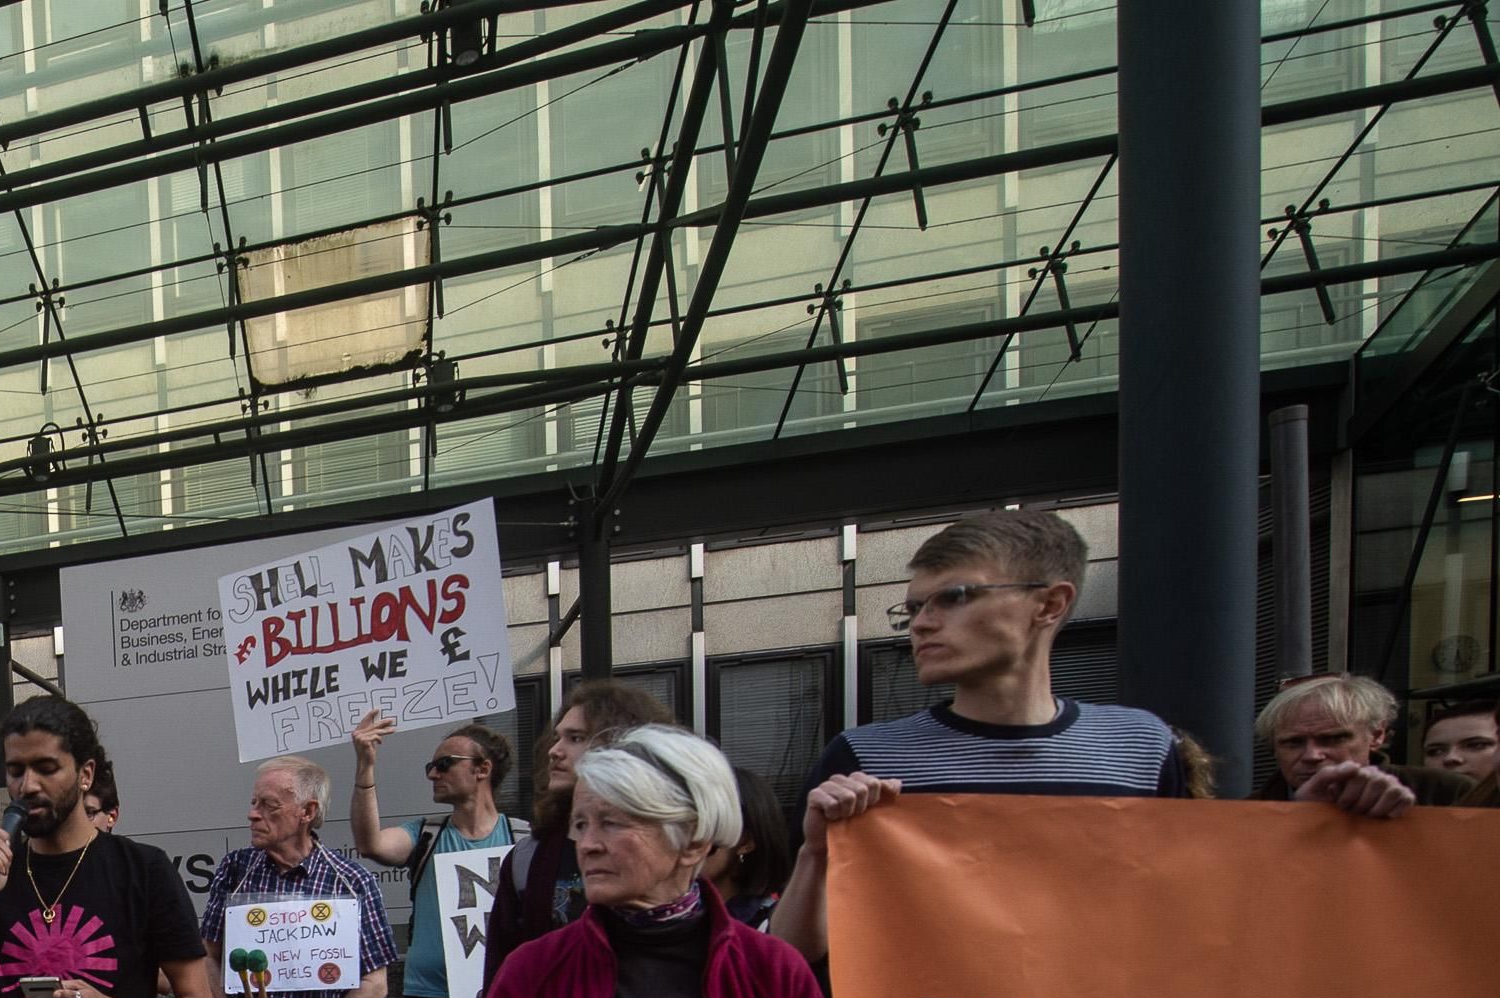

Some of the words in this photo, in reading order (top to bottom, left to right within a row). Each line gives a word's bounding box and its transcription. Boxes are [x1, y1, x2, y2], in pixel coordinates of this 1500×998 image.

[229, 556, 334, 624] SHELL
[349, 512, 474, 588] MAKES
[120, 610, 203, 633] Department
[207, 607, 222, 621] fo
[121, 632, 187, 650] Business,
[192, 626, 224, 641] Ener
[121, 653, 132, 666] &
[136, 645, 198, 664] Industrial
[246, 664, 339, 710] WHILE
[360, 649, 408, 682] WE
[271, 652, 500, 752] FREEZE!
[269, 910, 307, 926] STOP
[254, 921, 337, 944] JACKDAW
[273, 949, 301, 963] NEW
[310, 947, 354, 960] FOSSIL
[277, 966, 312, 980] FUELS
